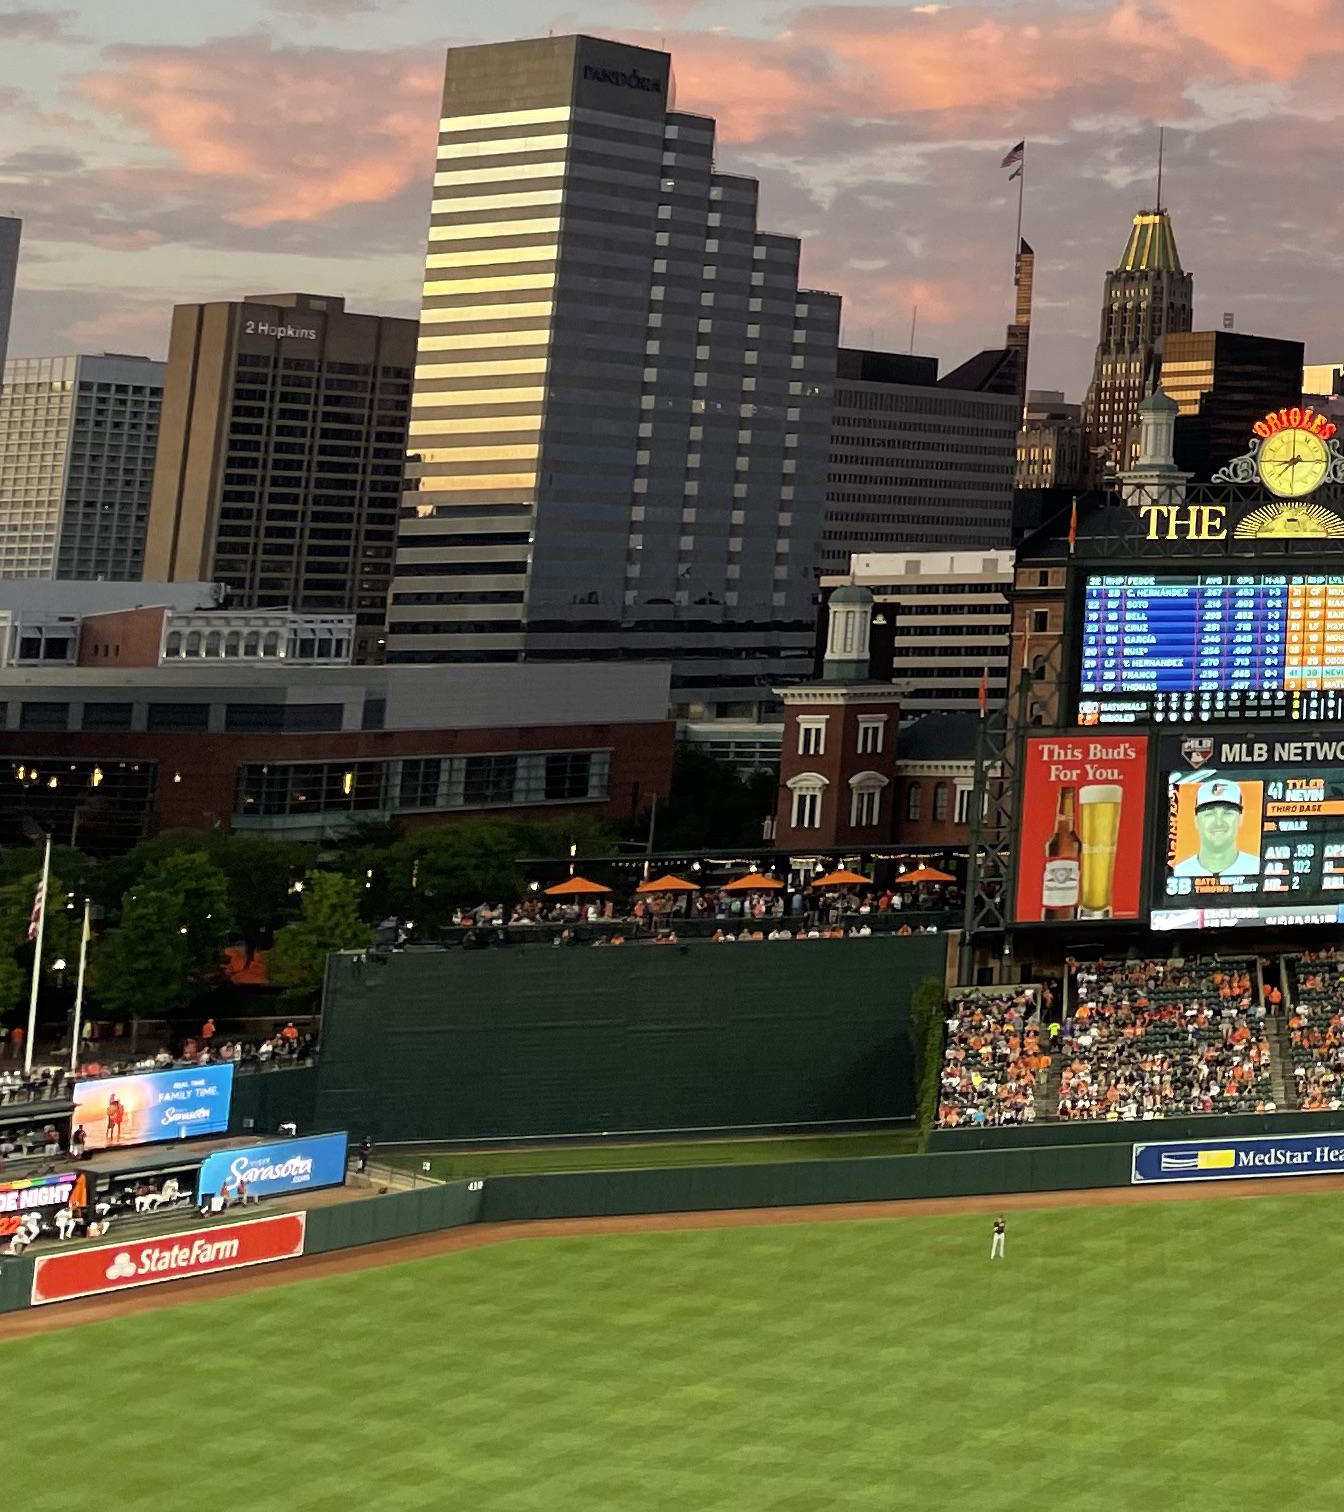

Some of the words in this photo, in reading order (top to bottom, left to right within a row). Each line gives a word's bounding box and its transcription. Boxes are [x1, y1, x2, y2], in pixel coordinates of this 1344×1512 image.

[245, 320, 254, 334] 2
[258, 322, 316, 340] Hopkins
[1252, 408, 1336, 440] ORIOLES
[1140, 506, 1227, 539] THE
[1206, 577, 1222, 585] AVG
[1126, 601, 1148, 609] SOTO
[1125, 624, 1148, 632] CRUZ
[1124, 634, 1156, 644] GARCÍA
[1122, 671, 1156, 679] FRANCO
[1122, 682, 1157, 691] THOMAS
[1101, 703, 1147, 711] NATIONALS
[1039, 744, 1082, 761] This
[1089, 743, 1136, 760] Bud's
[1221, 744, 1268, 763] MLB
[1049, 765, 1080, 781] For
[1085, 764, 1123, 780] You.
[1267, 782, 1283, 800] 41
[1286, 779, 1325, 790] TYLER
[1286, 790, 1324, 801] NEVIN
[1271, 805, 1297, 813] THIRD
[1299, 804, 1322, 813] BASE
[1279, 821, 1308, 831] WALK
[1294, 844, 1315, 858] .196
[1293, 860, 1311, 874] 102
[1166, 878, 1192, 895] 3B
[1291, 876, 1299, 890] 2
[159, 1089, 193, 1102] FAMILY
[1238, 1148, 1312, 1167] MedStar
[226, 1153, 313, 1190] Sarasota
[20, 1184, 72, 1209] NIGHT
